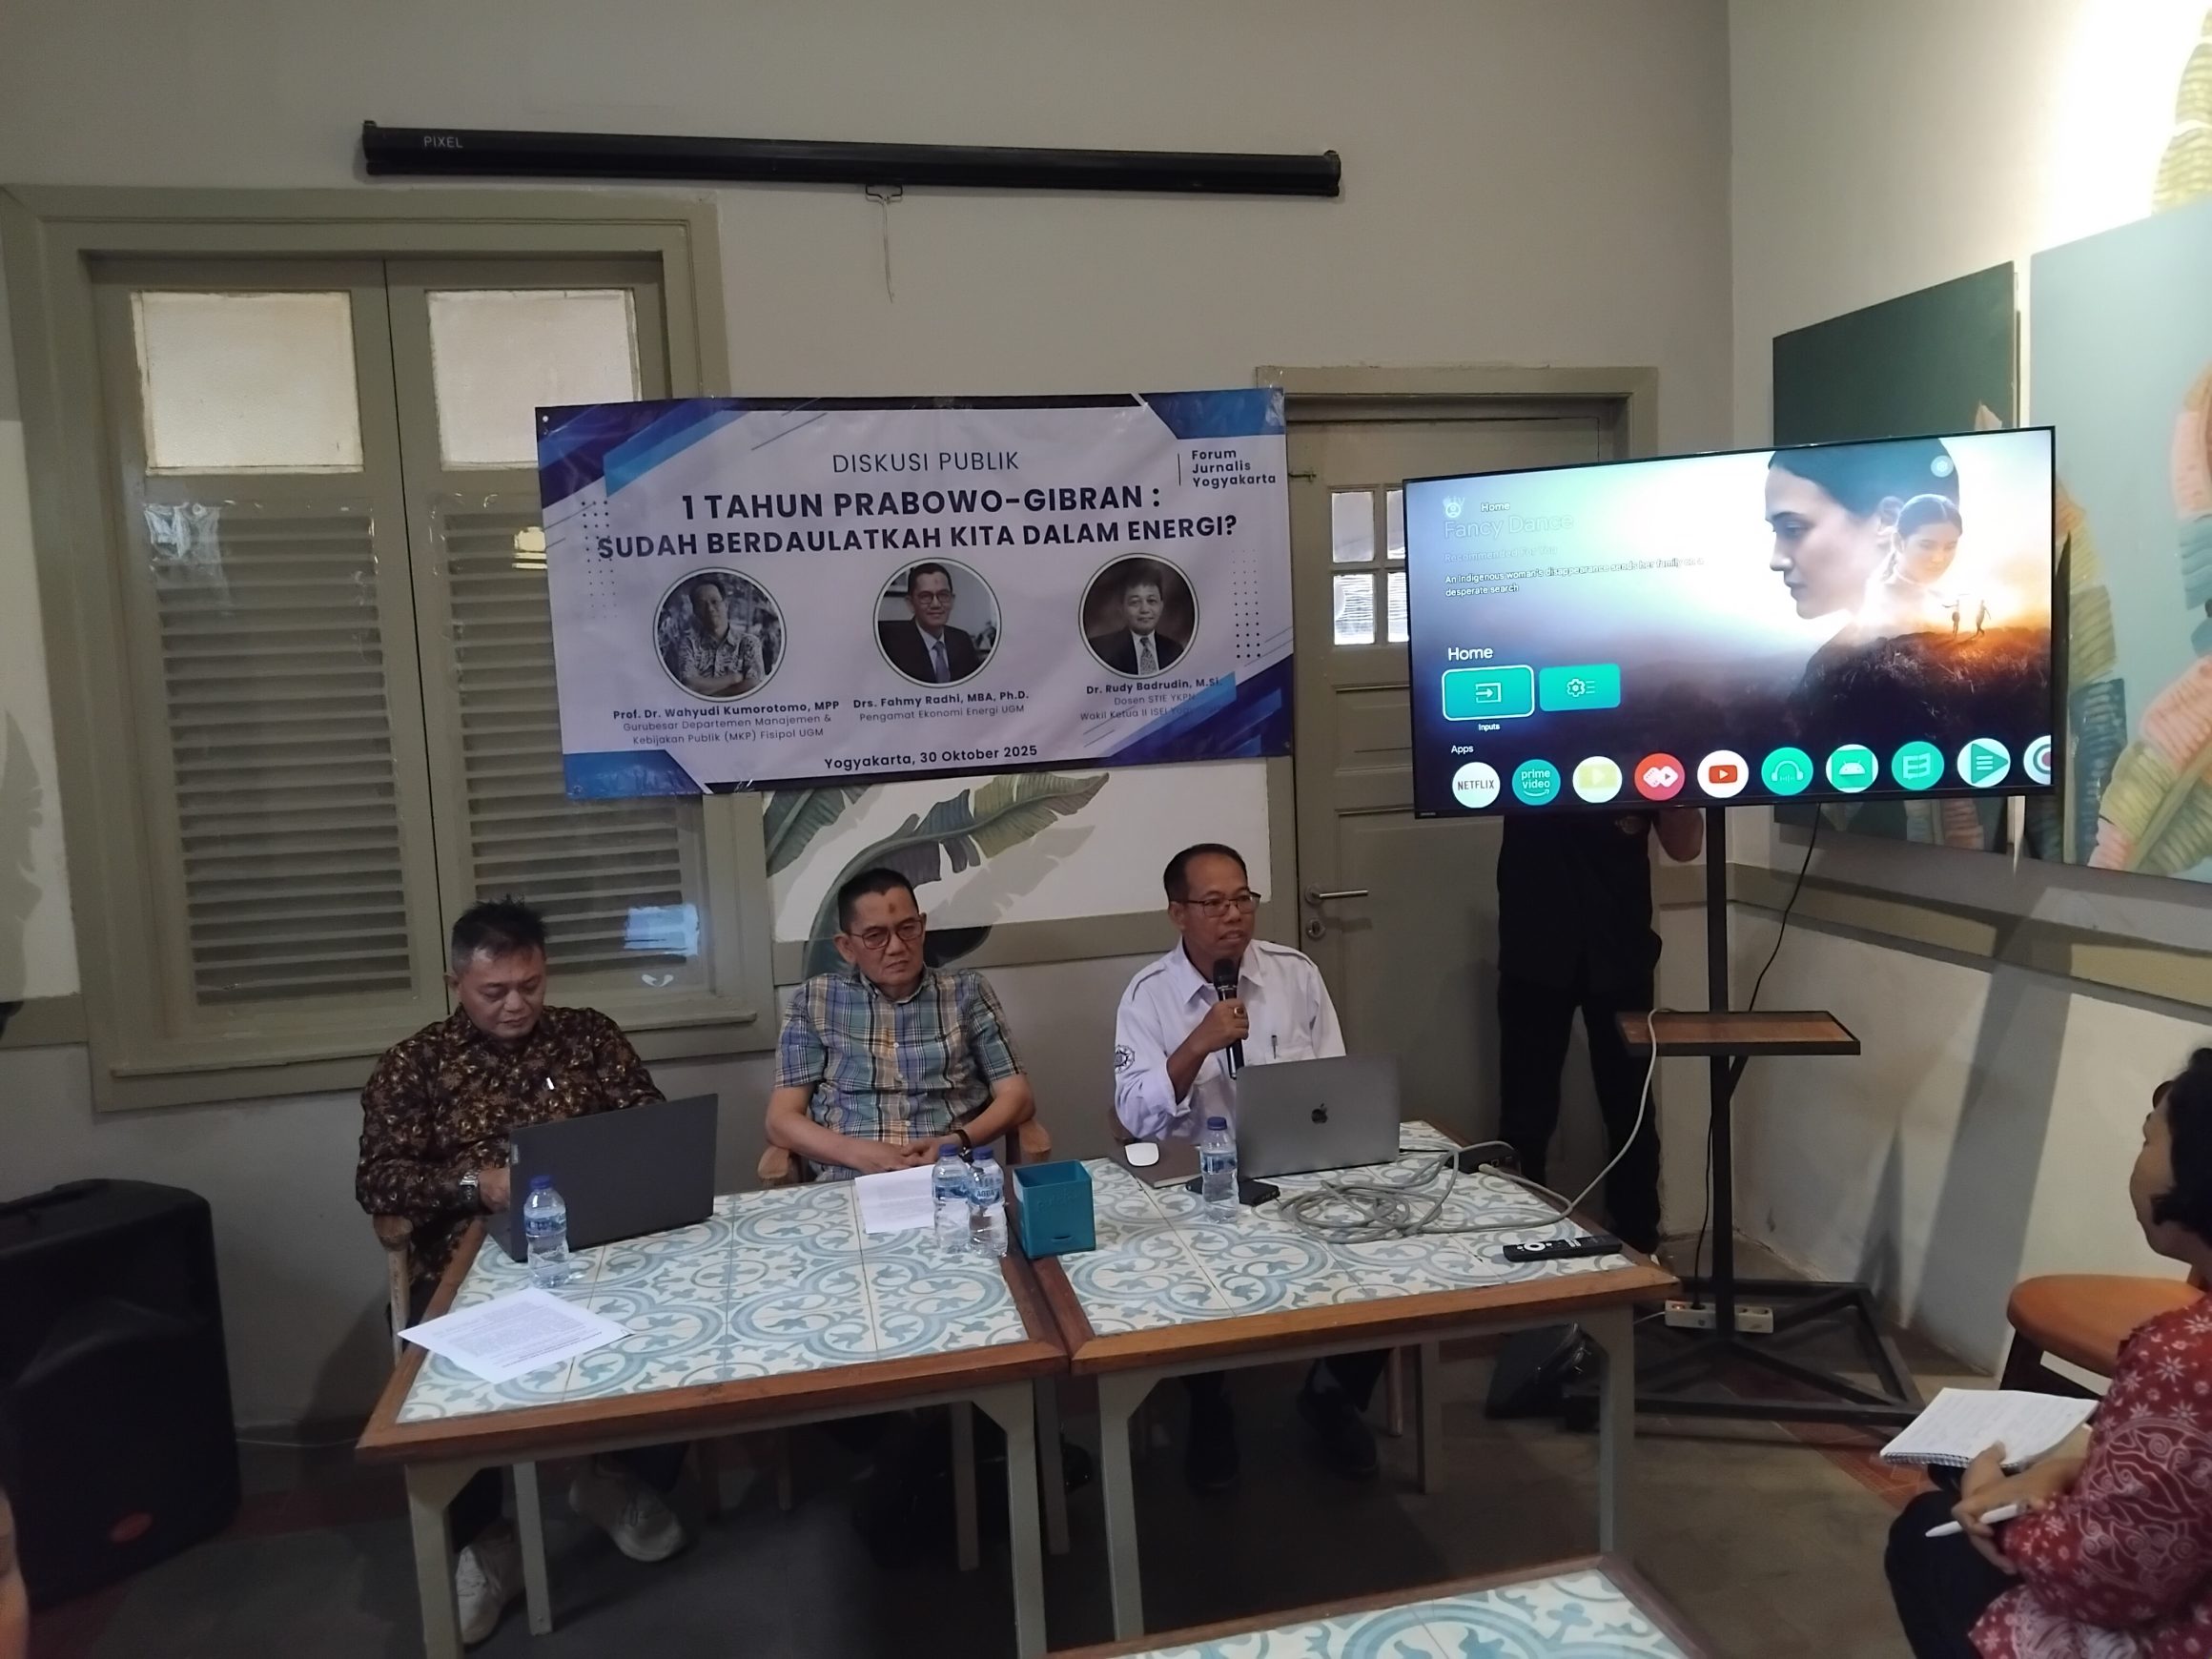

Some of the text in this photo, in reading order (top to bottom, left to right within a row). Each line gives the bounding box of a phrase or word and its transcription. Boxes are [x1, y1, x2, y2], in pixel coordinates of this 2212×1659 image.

[423, 135, 463, 149] PIXEL
[832, 451, 1019, 473] DISKUSI PUBLIK
[1192, 450, 1237, 460] Forum
[1192, 460, 1251, 474] Jurnalis
[1193, 474, 1276, 489] Yogyakarta
[682, 495, 694, 520] 1
[705, 493, 823, 520] TAHUN
[834, 485, 1142, 517] PRABOWO-GIBRAN
[1481, 502, 1511, 513] Home
[1444, 514, 1574, 541] Fancy Dance
[598, 515, 1238, 559] SUDAH BERDAULATKAH KITA DALAM ENERGI?
[1444, 547, 1519, 563] Recommended
[1445, 576, 1457, 584] An
[1459, 572, 1505, 584] Indigenous
[1505, 568, 1544, 580] woman's
[1445, 584, 1519, 598] desperate search
[1447, 646, 1494, 661] Home
[1086, 685, 1103, 695] Dr.
[1105, 683, 1133, 694] Rudy
[1137, 679, 1193, 691] Badrudin,
[853, 690, 1030, 708] Drs. Fahmy Radhi, MBA, Ph.D.
[1114, 696, 1145, 706] Dosen
[1148, 694, 1168, 704] STIE
[613, 701, 840, 720] Prof. Dr. Wahyudi Kumorotomo, MPP
[859, 705, 1025, 723] Pengamat Ekonomi Energi UGM
[1080, 711, 1107, 721] Wakil
[1110, 708, 1138, 719] Ketua
[623, 714, 831, 732] Gurubesar Departemen Manajemen &
[1478, 724, 1501, 732] Inputs
[633, 727, 824, 746] Kebijakan Publik (MKP) Fisipol UGM
[1450, 745, 1474, 754] Apps
[824, 745, 1037, 771] Yogyakarta, 30 Oktober 2025
[1521, 768, 1550, 781] prime
[1458, 780, 1494, 790] NETFLIX
[1522, 778, 1550, 789] video
